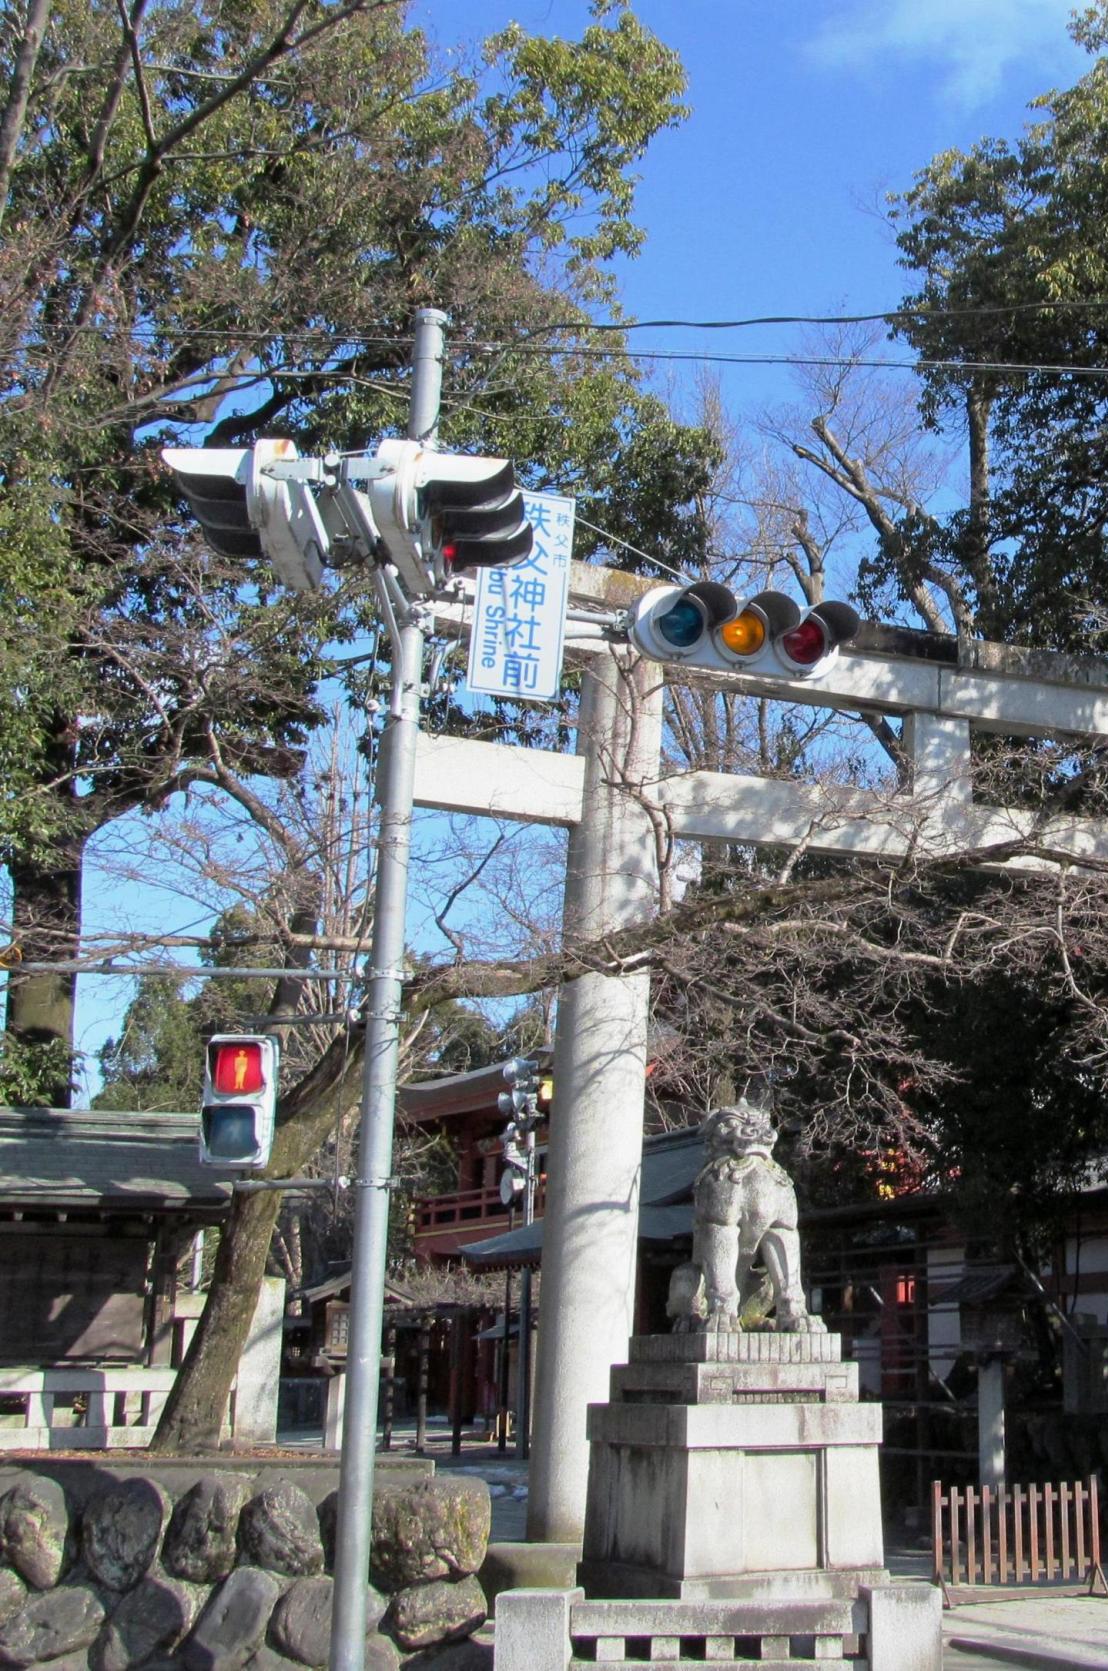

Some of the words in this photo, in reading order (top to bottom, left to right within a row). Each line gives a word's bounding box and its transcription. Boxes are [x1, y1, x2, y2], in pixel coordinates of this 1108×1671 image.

[553, 512, 571, 568] 秩父市
[481, 604, 505, 669] Shrine
